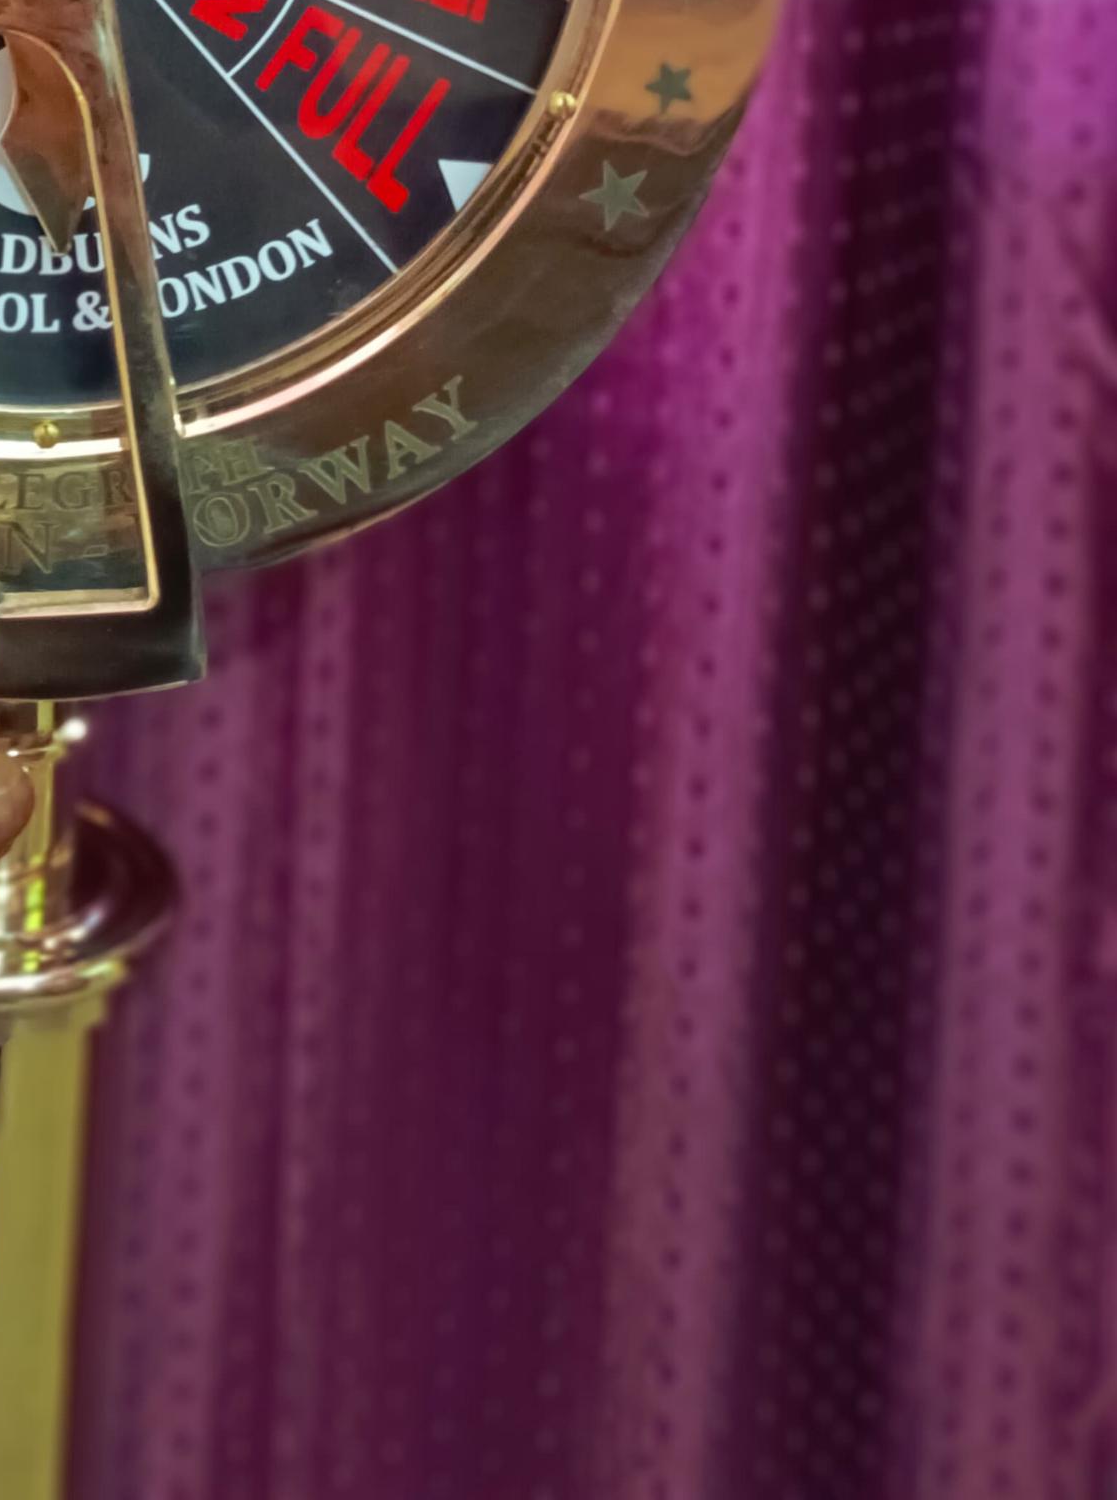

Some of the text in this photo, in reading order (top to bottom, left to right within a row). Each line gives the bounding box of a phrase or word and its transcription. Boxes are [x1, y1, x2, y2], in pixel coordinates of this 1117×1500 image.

[255, 5, 451, 214] FULL
[72, 290, 114, 331] &
[157, 217, 334, 319] ONDON
[133, 375, 478, 565] ORWAY
